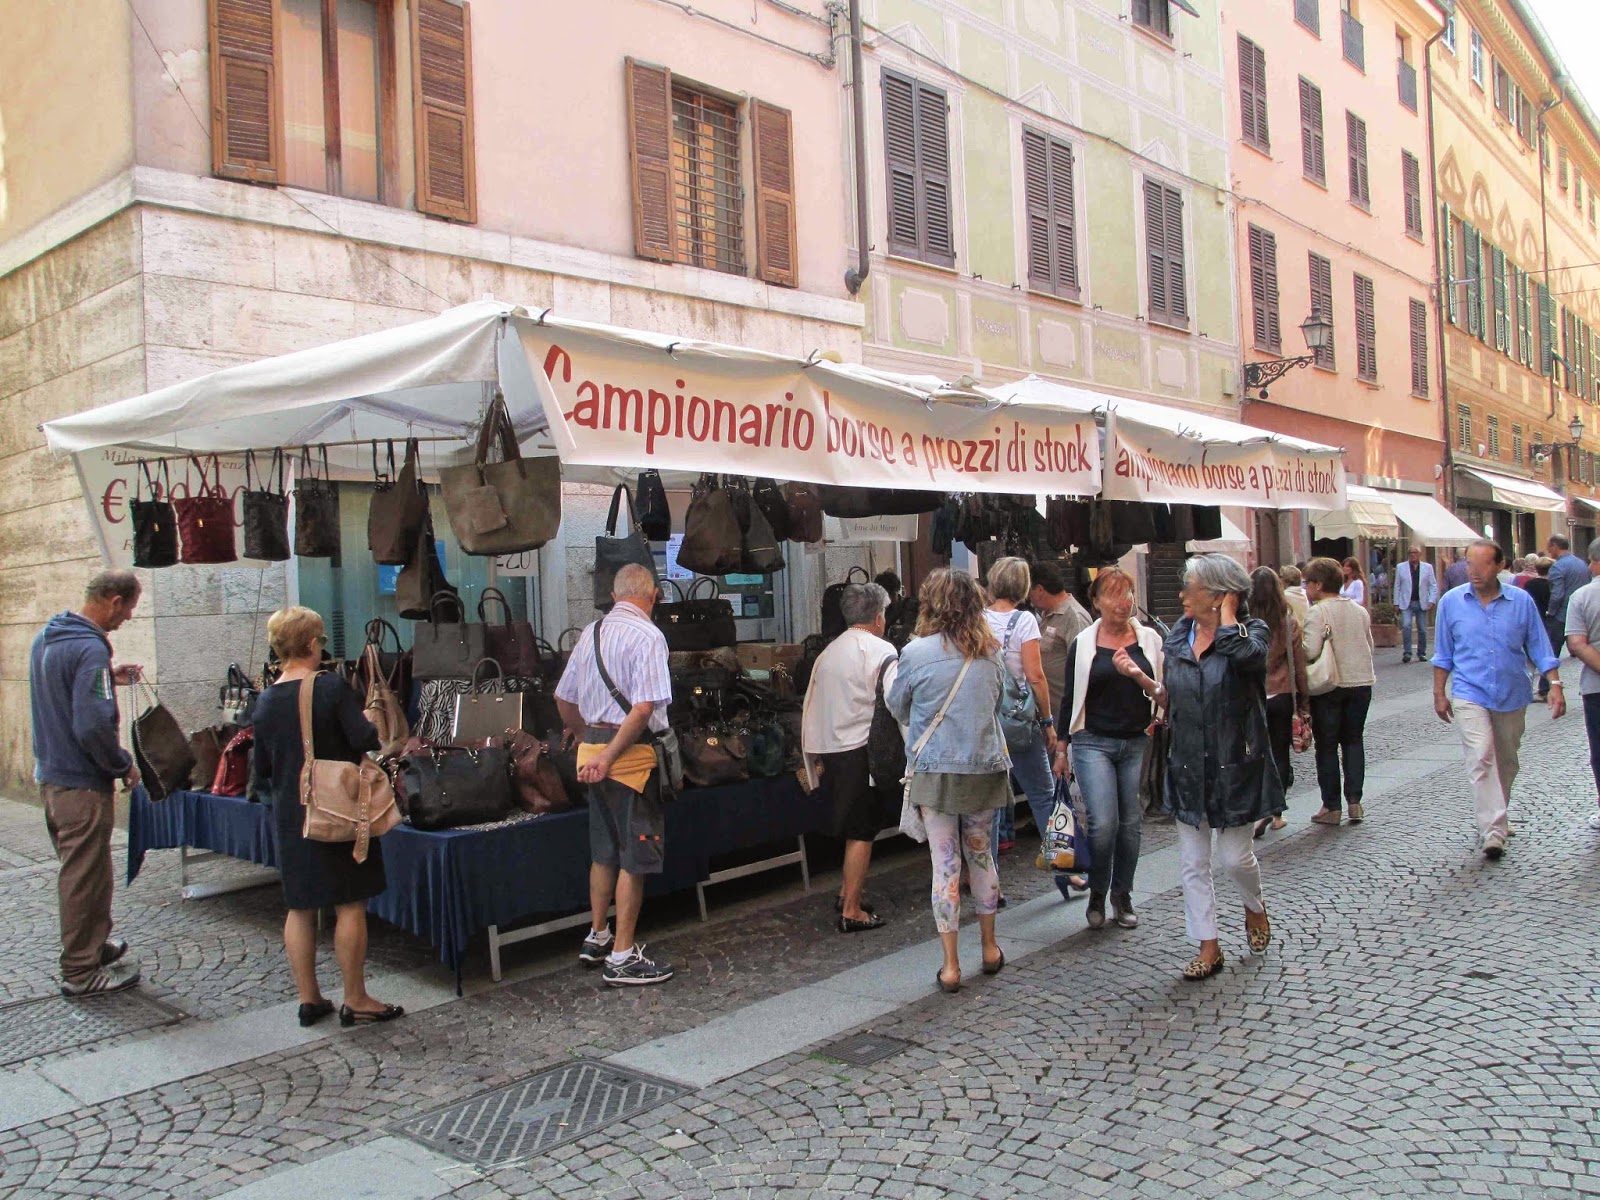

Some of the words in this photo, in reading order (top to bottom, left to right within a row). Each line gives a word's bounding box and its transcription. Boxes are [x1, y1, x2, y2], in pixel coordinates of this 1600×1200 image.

[543, 344, 814, 455] Campionario
[823, 391, 896, 465] borse
[901, 431, 918, 467] a
[922, 426, 1001, 482] prezzi
[1007, 421, 1027, 472] di
[1034, 423, 1092, 472] stock
[1113, 434, 1199, 492] ampionario
[1201, 449, 1246, 490] borse
[1248, 465, 1259, 490] a
[1262, 461, 1292, 499] pezzi
[1295, 457, 1305, 492] di
[1308, 460, 1338, 494] stock
